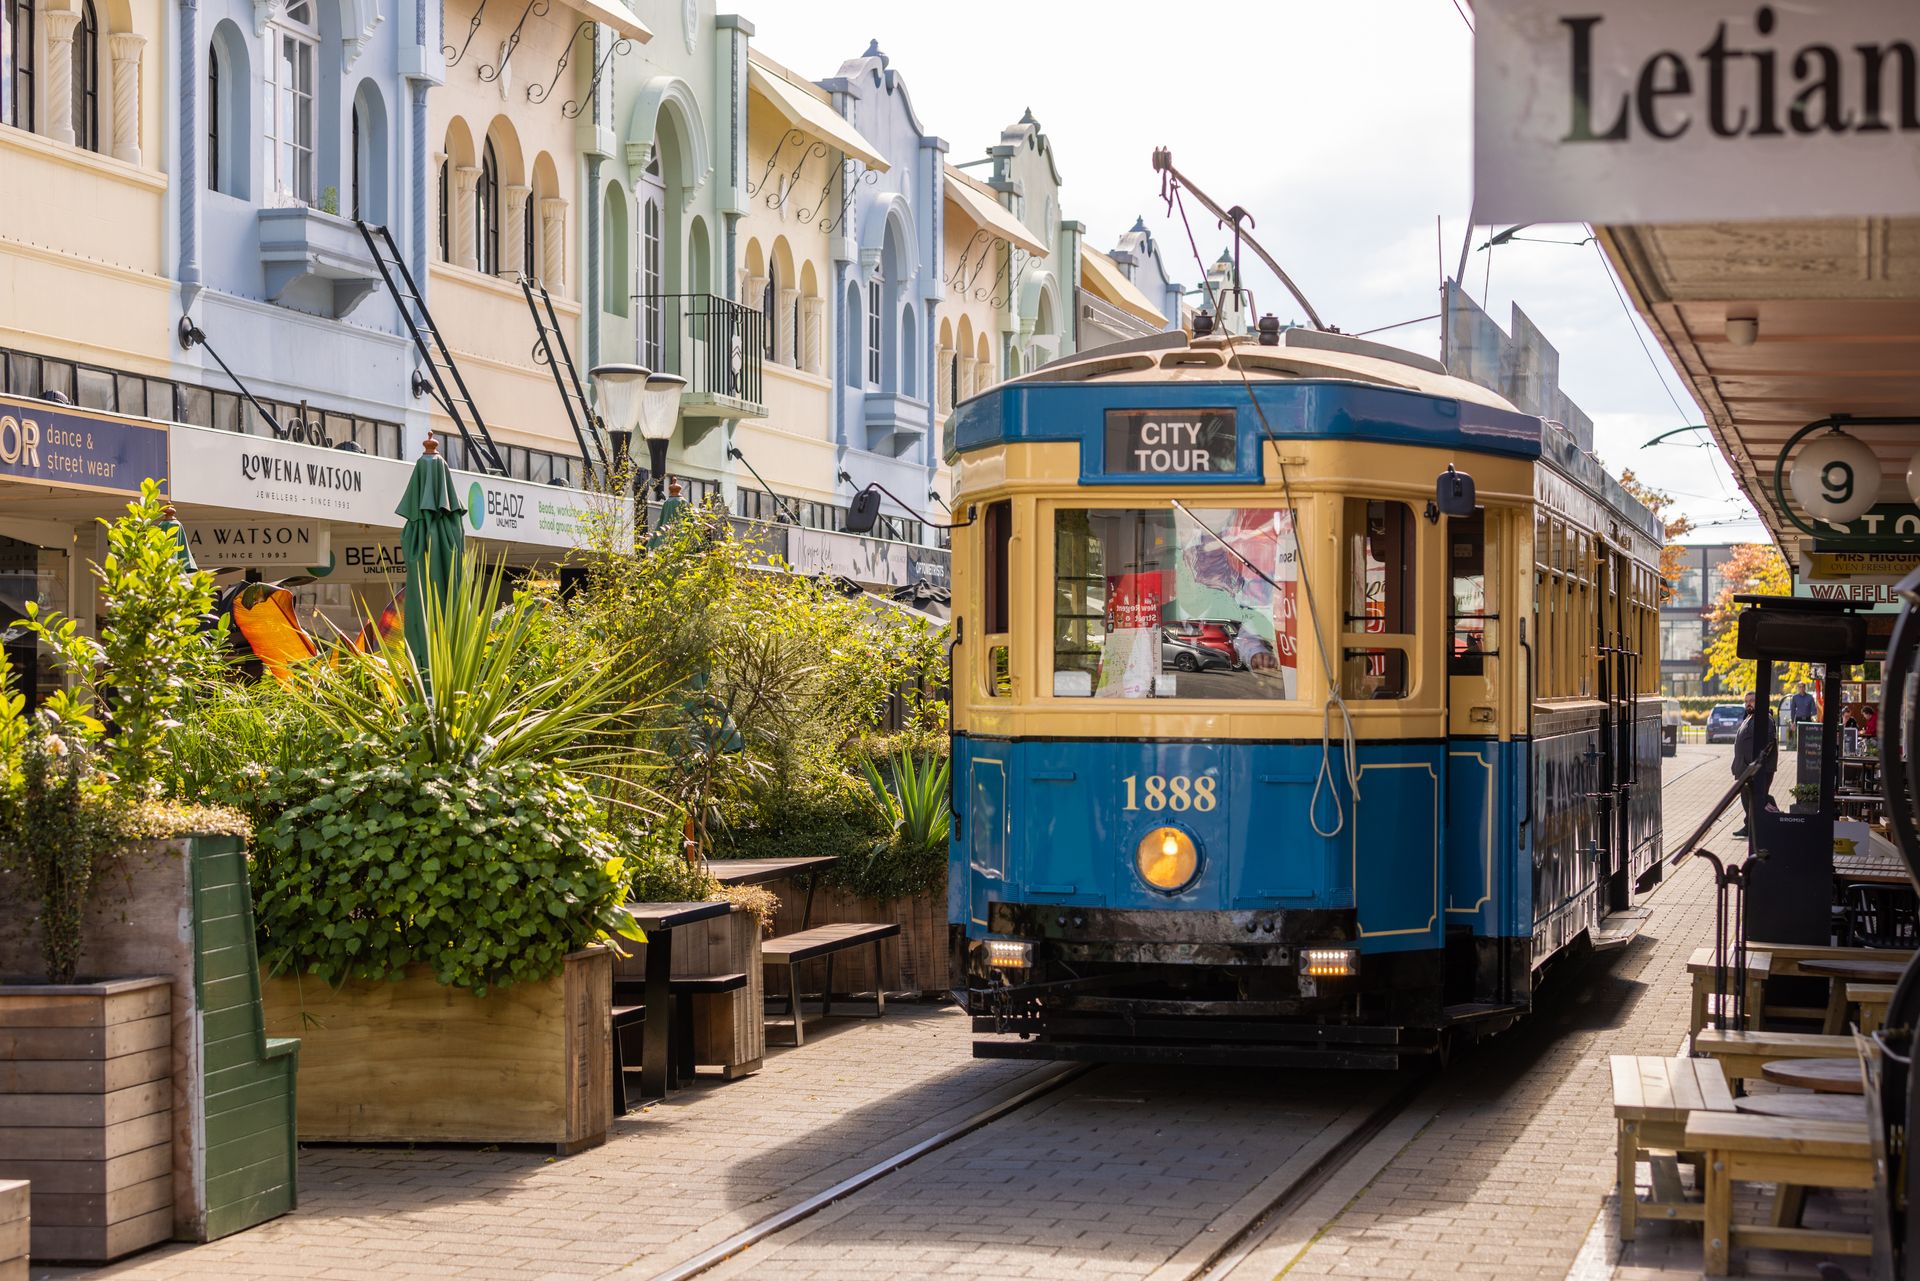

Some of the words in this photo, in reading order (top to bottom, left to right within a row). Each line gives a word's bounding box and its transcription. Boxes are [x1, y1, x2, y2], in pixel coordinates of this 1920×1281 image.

[1559, 4, 1920, 143] Letian
[46, 423, 82, 449] dance
[86, 432, 94, 450] &
[1140, 422, 1202, 445] CITY
[47, 453, 84, 474] street
[87, 460, 117, 478] wear
[1134, 449, 1210, 472] TOUR
[242, 453, 302, 484] ROWENA
[306, 463, 361, 492] WATSON
[1821, 460, 1854, 504] 9
[256, 490, 298, 502] JEWELLERS
[310, 496, 331, 507] SINCE
[487, 490, 525, 519] BEADZ
[495, 516, 518, 529] UNLIMITED
[213, 527, 310, 545] WATSON
[345, 546, 405, 566] BEAD
[363, 566, 408, 574] UNLIMITED
[1809, 584, 1900, 604] WAFFLE
[1121, 775, 1217, 812] 1888
